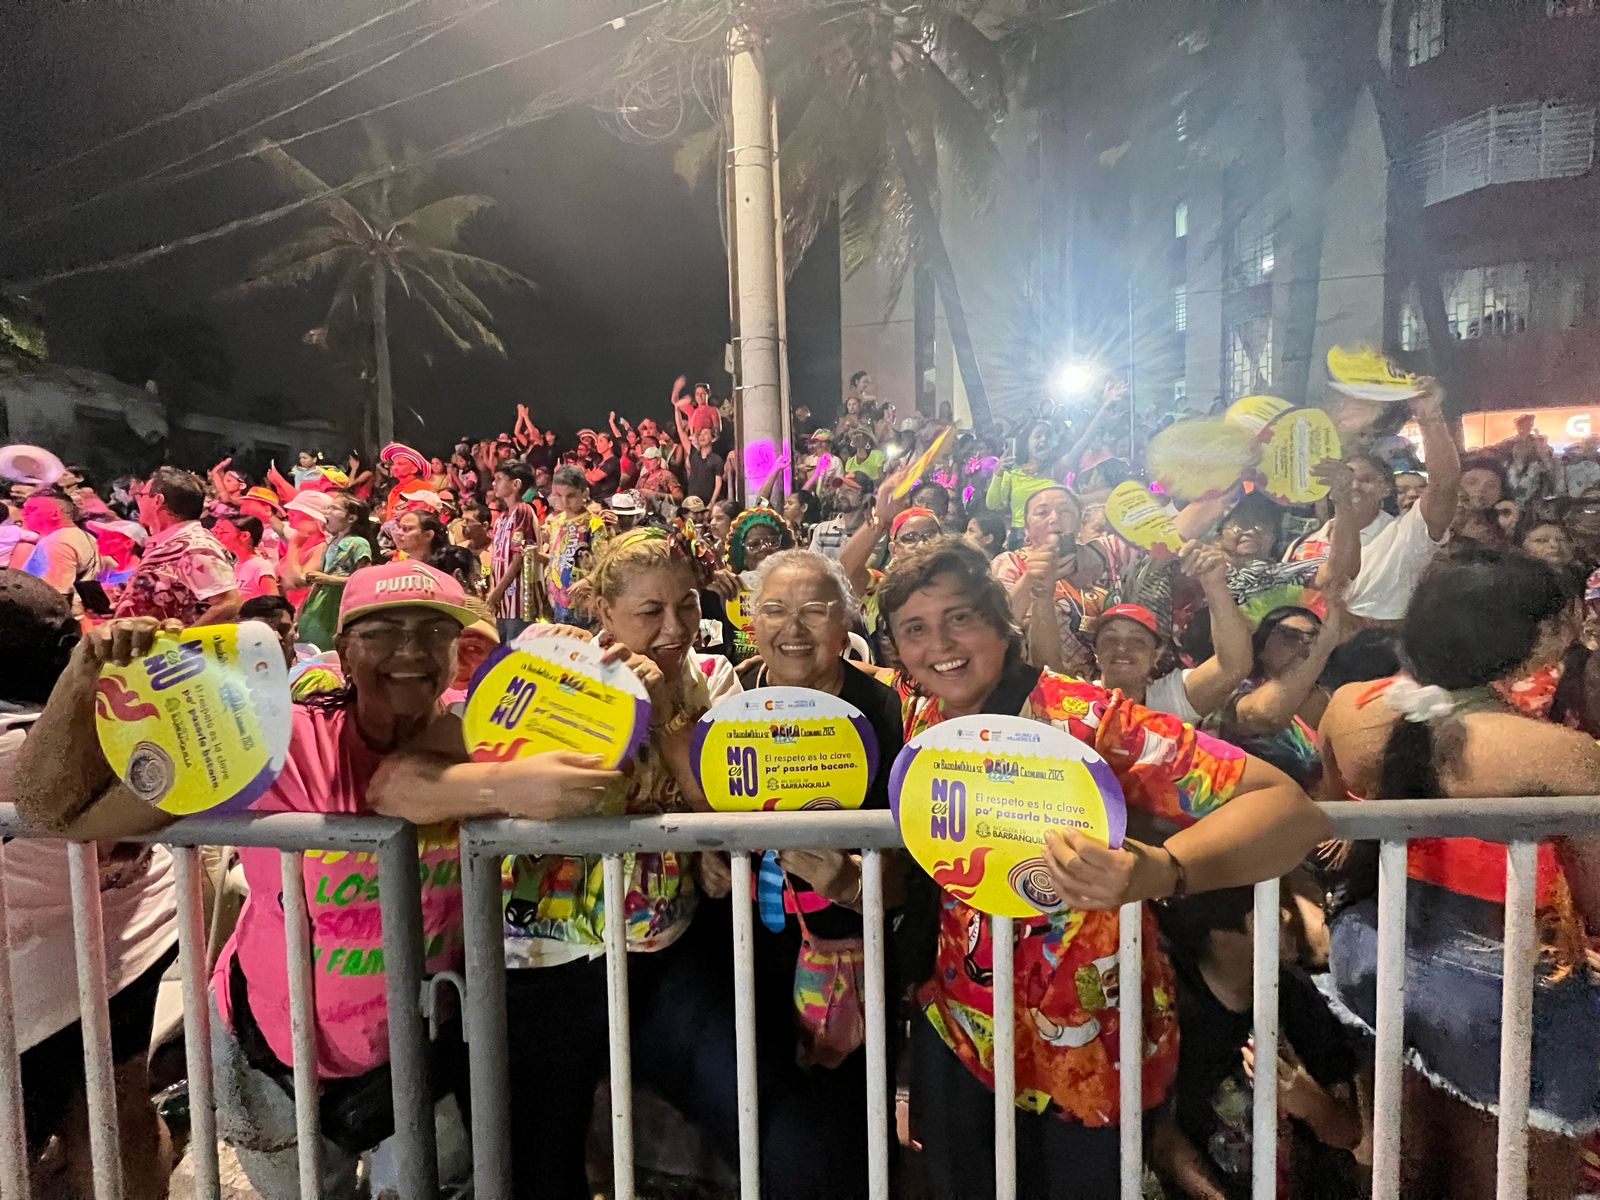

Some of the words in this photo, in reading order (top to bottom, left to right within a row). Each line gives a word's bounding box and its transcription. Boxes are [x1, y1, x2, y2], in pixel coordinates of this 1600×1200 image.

[1566, 414, 1591, 438] G
[376, 575, 433, 593] PUMA
[823, 726, 836, 736] 2025
[774, 754, 806, 763] respeto
[820, 752, 828, 760] la
[830, 752, 852, 760] clave
[728, 765, 742, 777] es
[783, 764, 818, 774] pasarla
[821, 762, 858, 771] bacano.
[1048, 769, 1065, 781] 2025
[781, 781, 831, 790] BARRANQUILLA
[931, 802, 948, 816] es
[975, 793, 983, 802] El
[986, 795, 1024, 808] respeto
[1027, 800, 1039, 809] es
[1042, 800, 1053, 811] la
[1056, 802, 1085, 815] clave
[996, 810, 1040, 822] pasarla
[1044, 813, 1094, 830] bacano.
[992, 830, 1046, 845] BARRANQUIL
[326, 947, 386, 977] FAM
